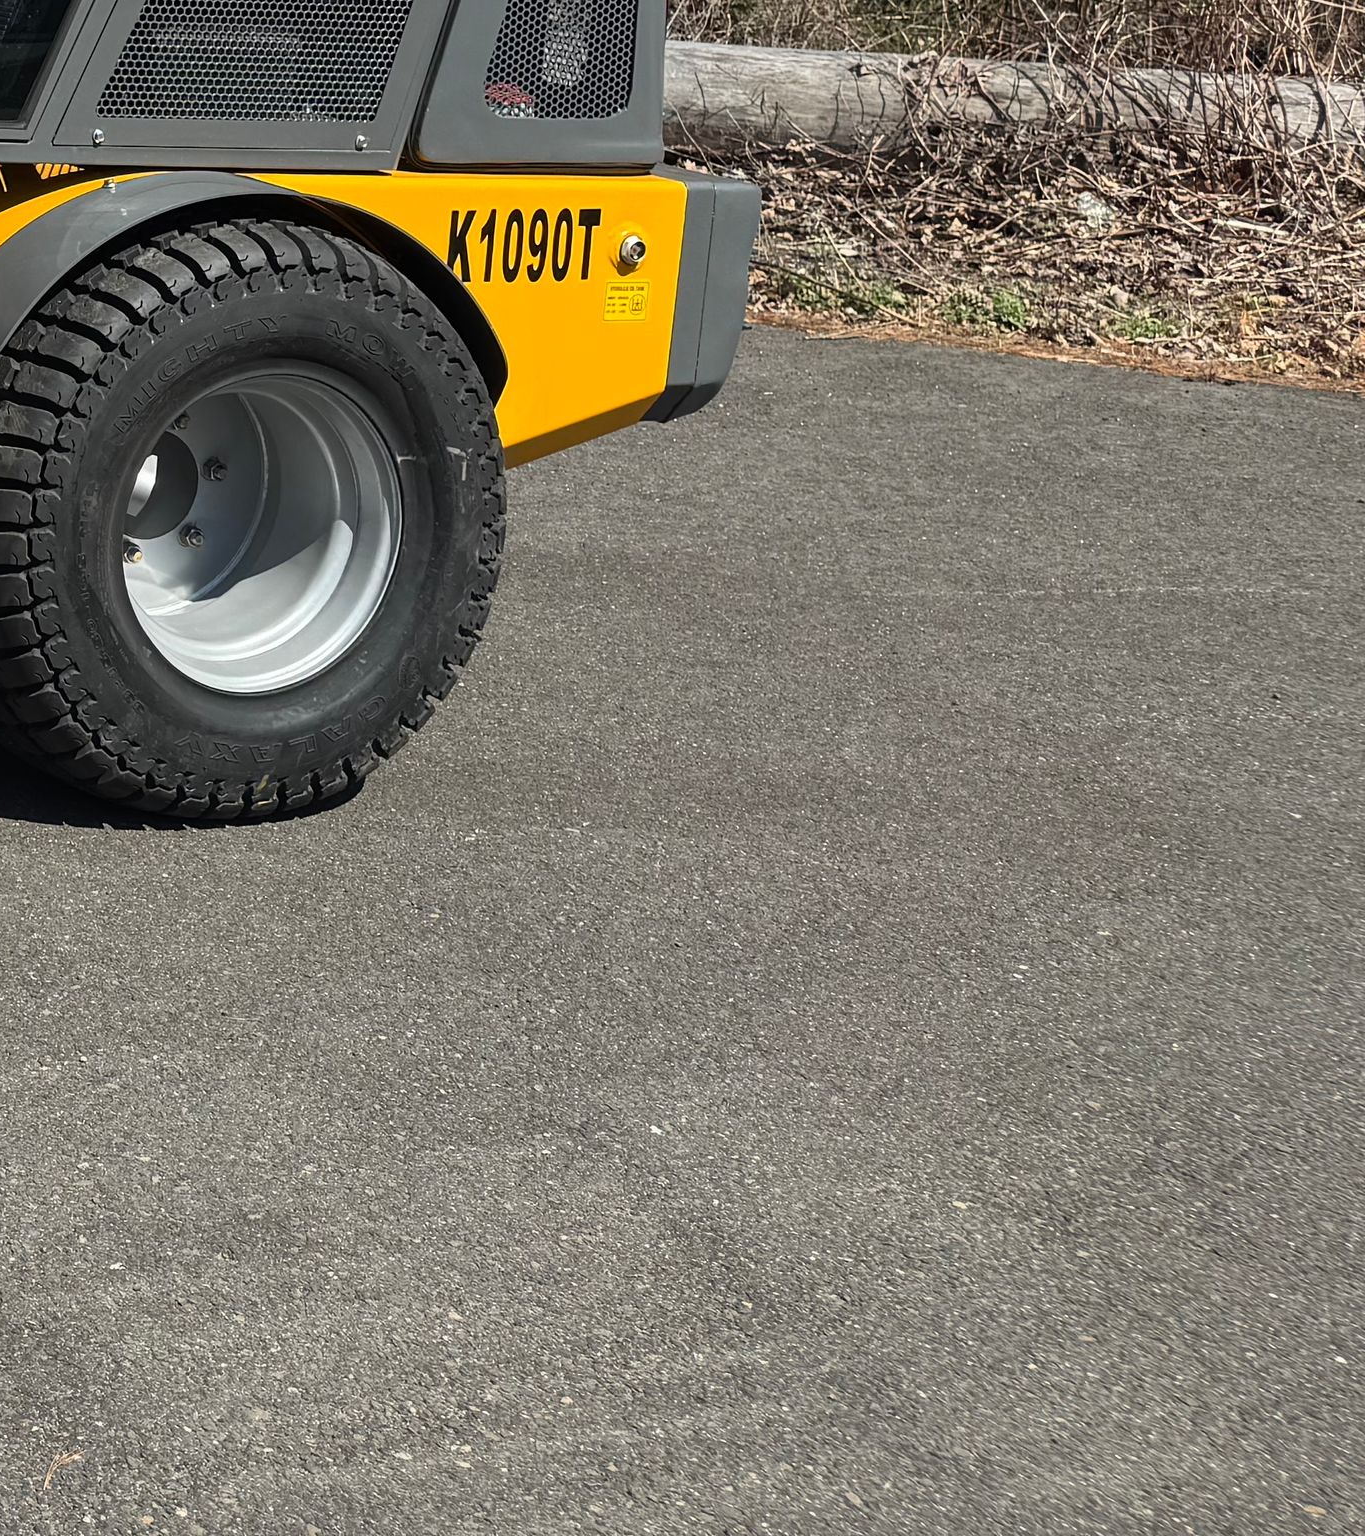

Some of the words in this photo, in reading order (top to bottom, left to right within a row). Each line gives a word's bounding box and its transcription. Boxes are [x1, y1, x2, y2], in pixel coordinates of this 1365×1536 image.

[447, 208, 602, 283] K1090T
[113, 313, 288, 433] MIGHTY
[326, 319, 416, 390] MOW
[174, 695, 389, 767] GALAXY
